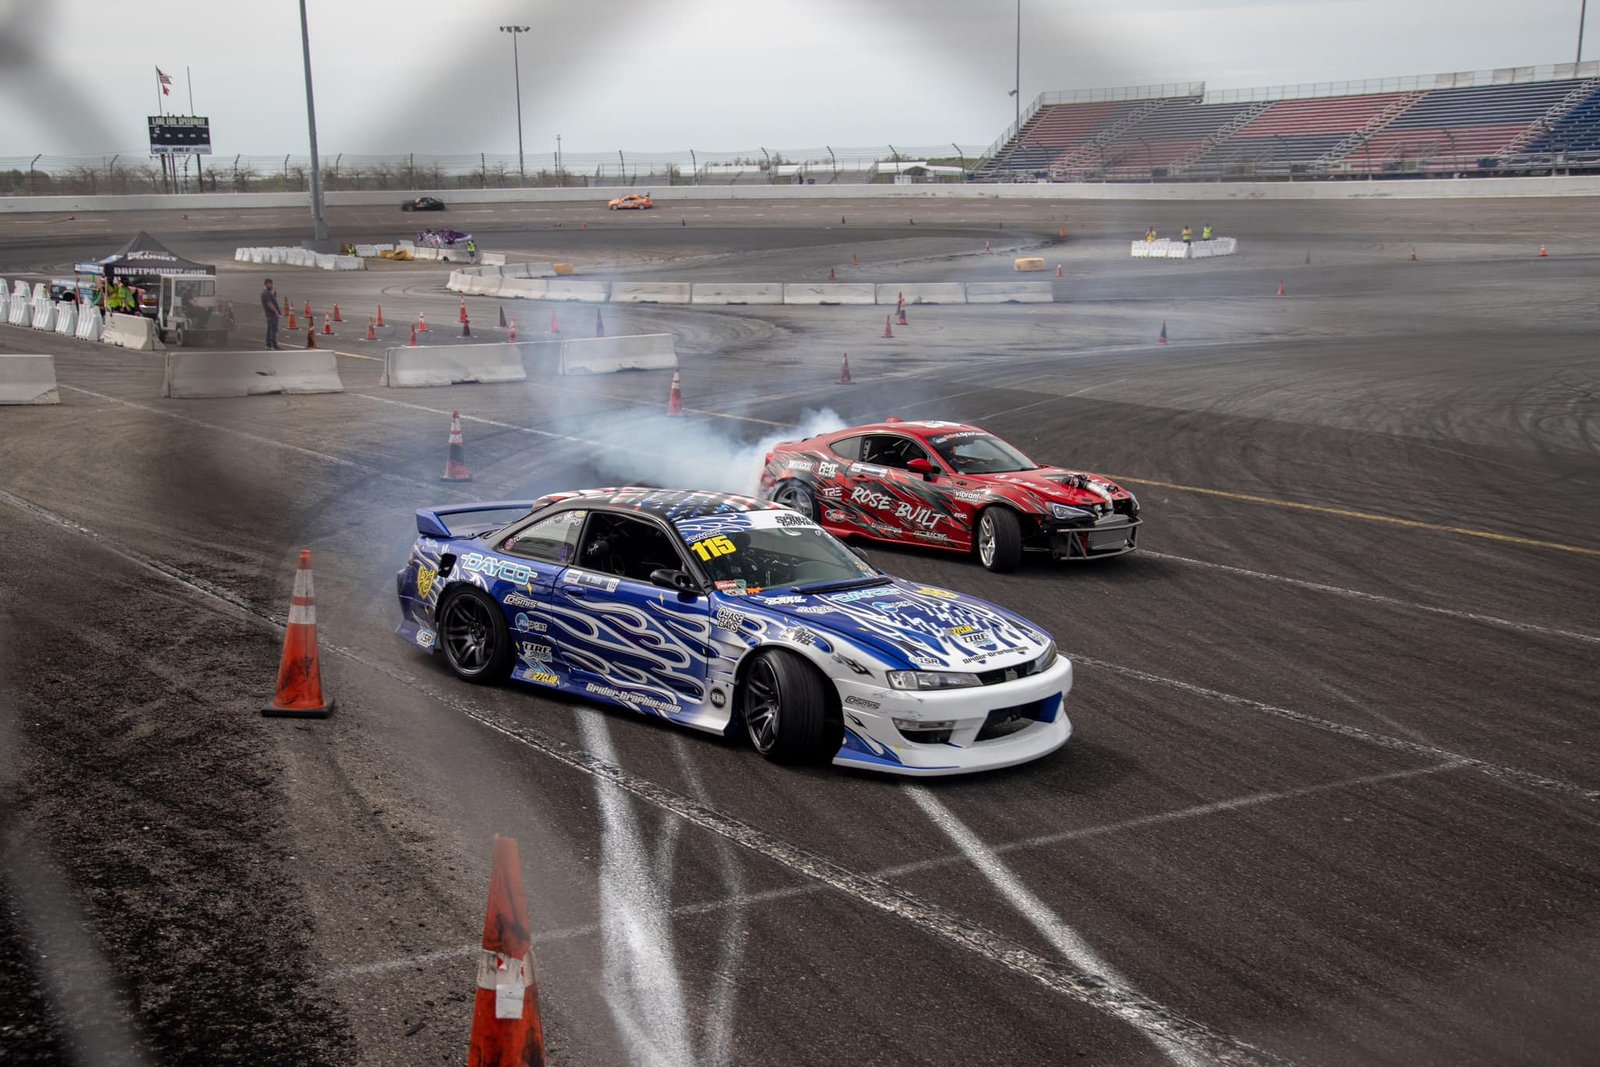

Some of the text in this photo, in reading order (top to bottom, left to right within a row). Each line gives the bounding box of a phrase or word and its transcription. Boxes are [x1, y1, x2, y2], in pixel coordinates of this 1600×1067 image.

[851, 486, 892, 510] ROSE
[895, 501, 946, 529] BUILT
[691, 535, 736, 561] 115
[461, 553, 537, 585] DAYCO
[718, 607, 744, 624] CHASE
[719, 620, 738, 632] BAYS
[522, 641, 551, 653] TIRE
